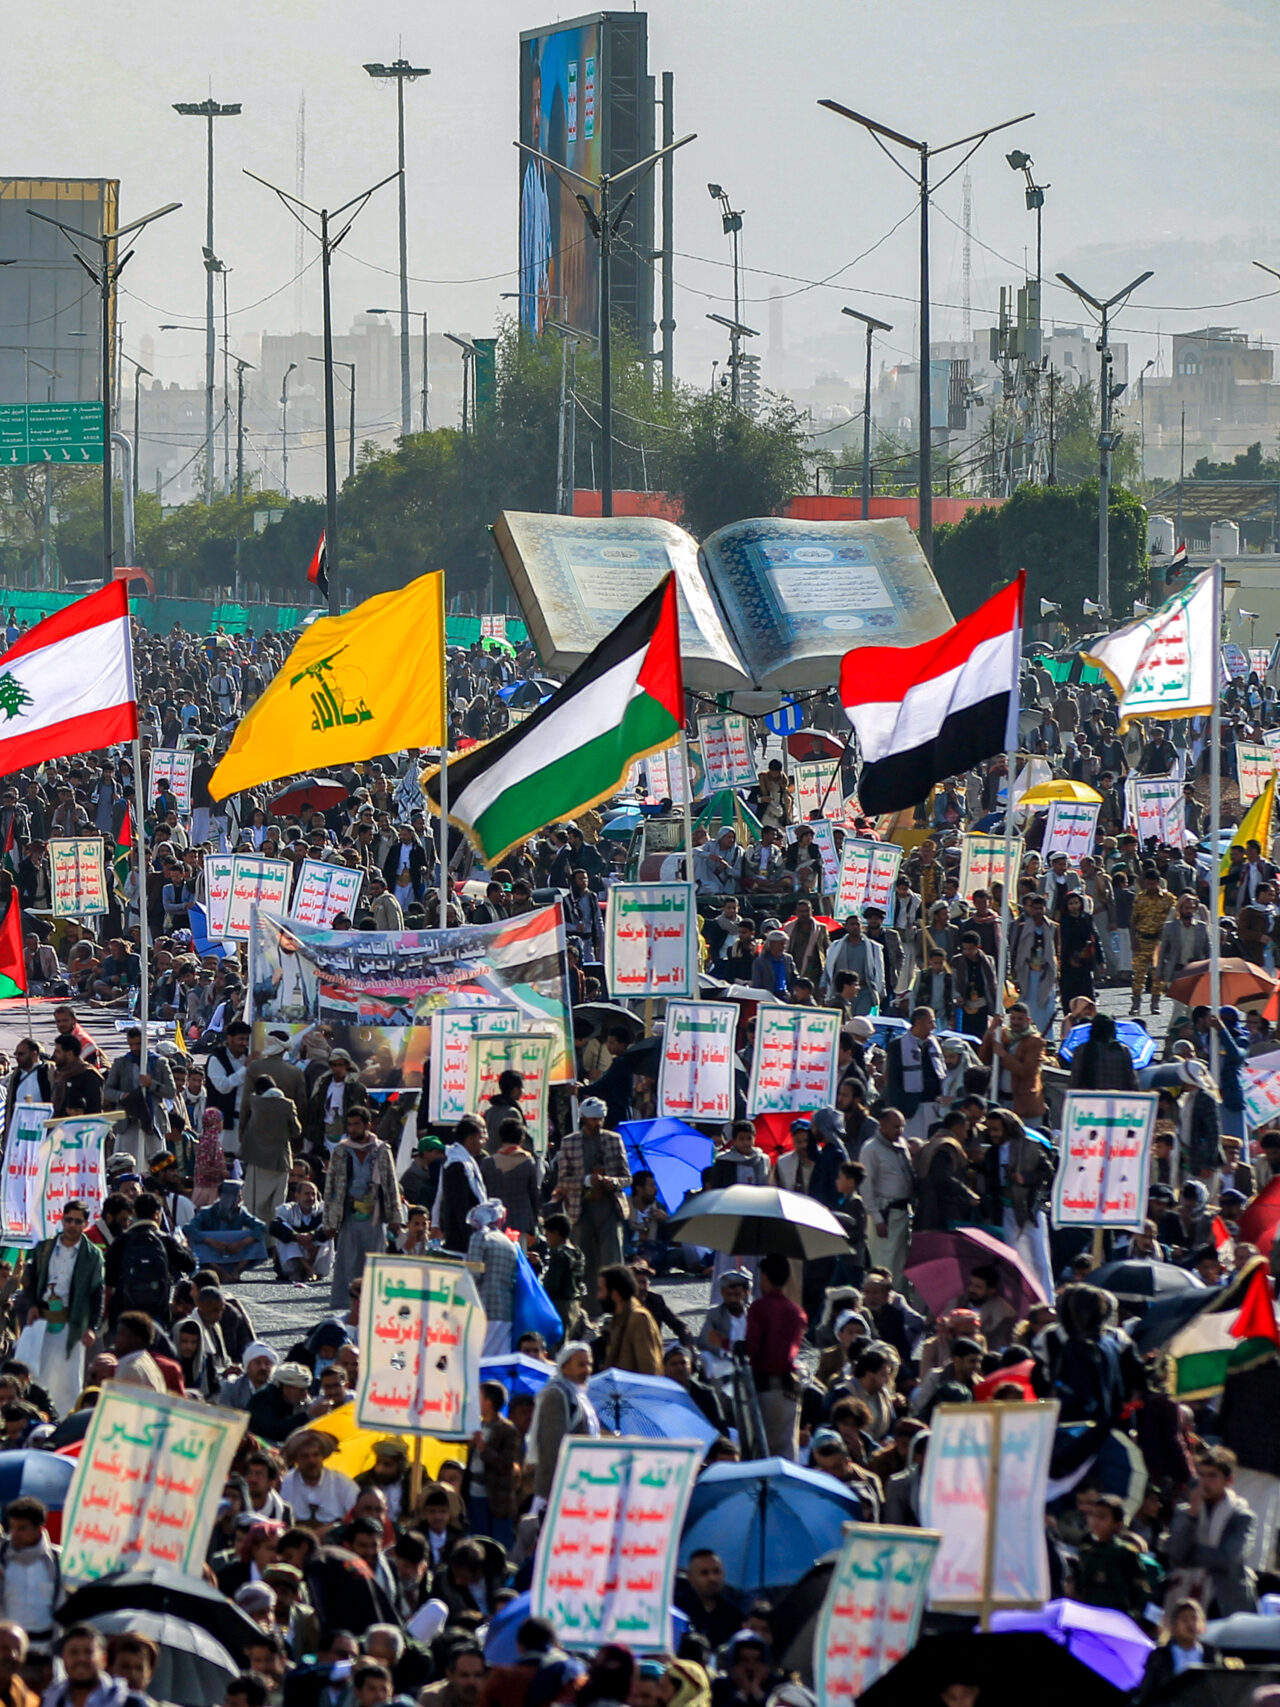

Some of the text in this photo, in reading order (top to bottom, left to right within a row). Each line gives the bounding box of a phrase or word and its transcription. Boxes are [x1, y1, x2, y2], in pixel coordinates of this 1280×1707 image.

[618, 894, 686, 918] قاطعوا
[672, 1010, 730, 1037] قاطعوا
[807, 1017, 833, 1033] الله
[1073, 1107, 1146, 1131] قاطعوا
